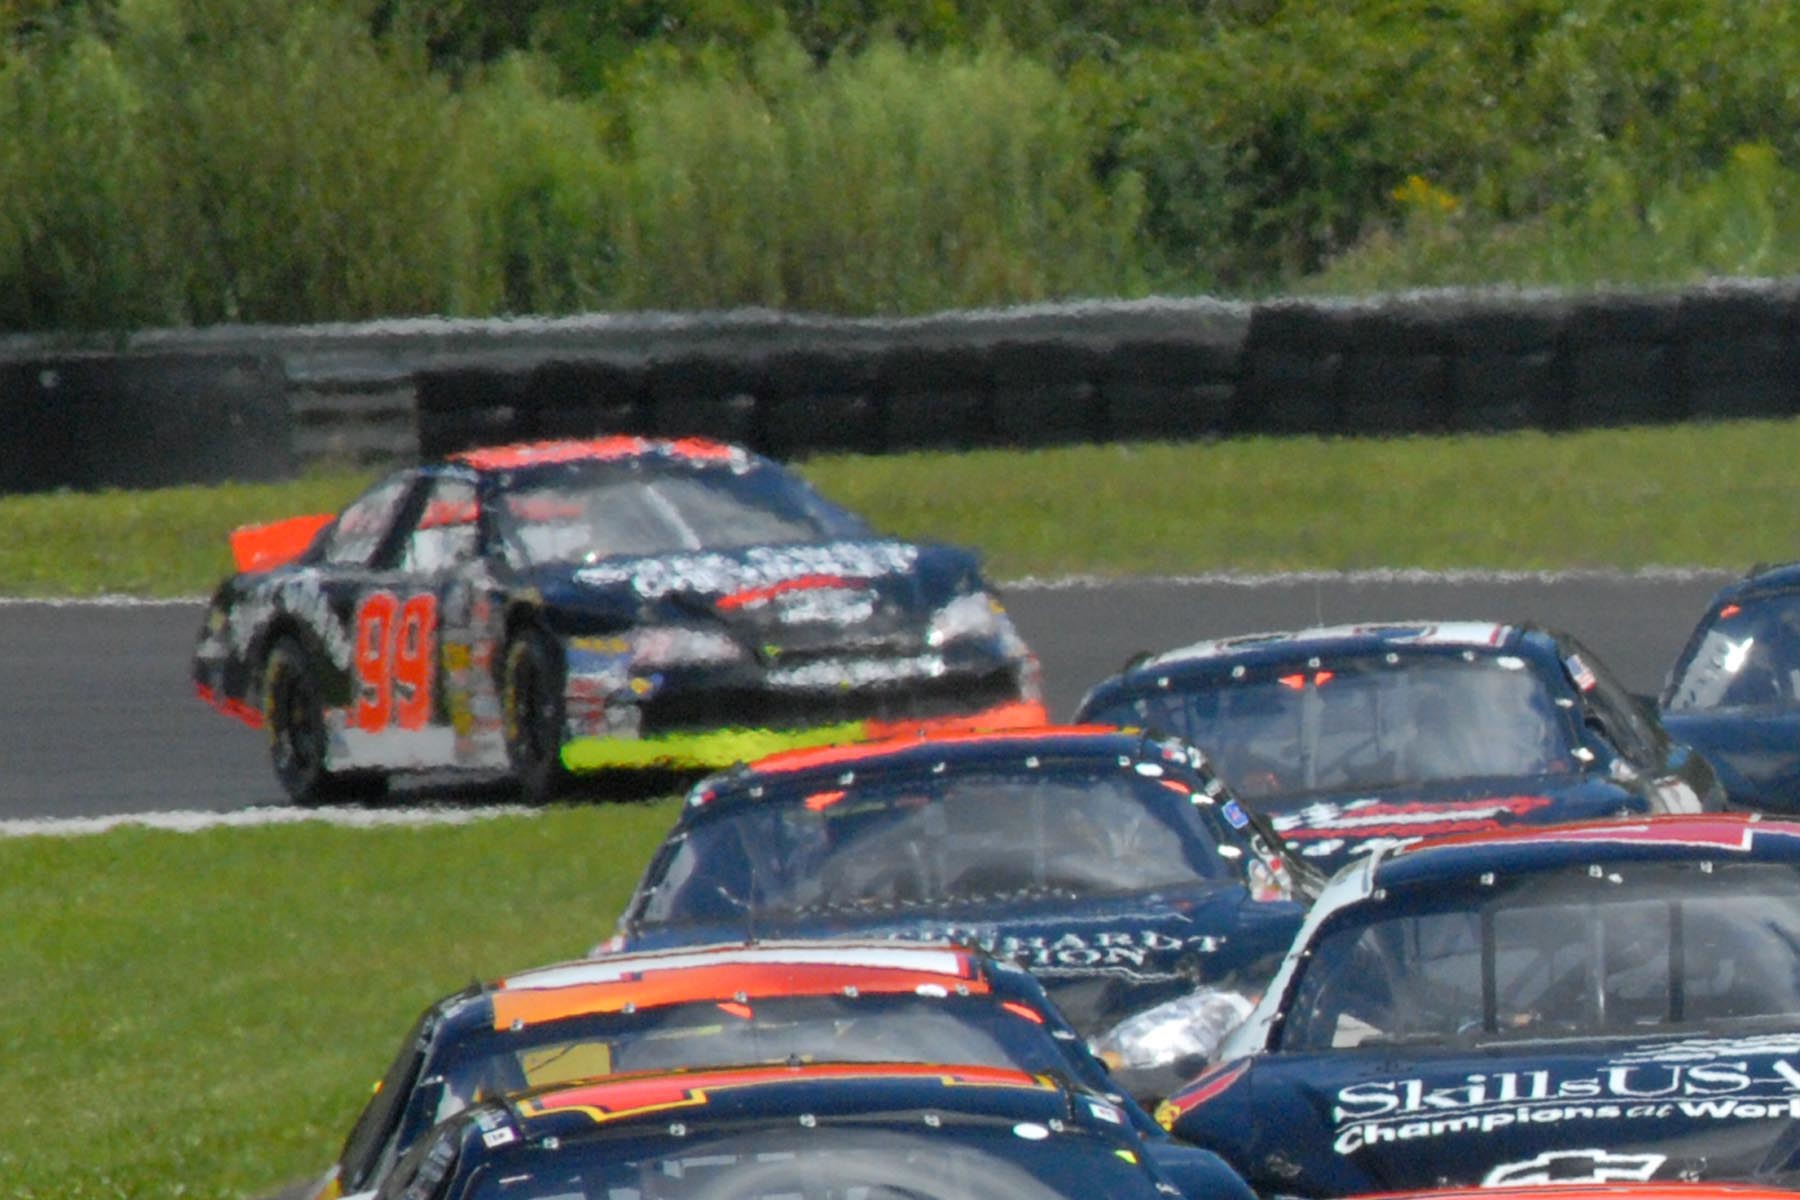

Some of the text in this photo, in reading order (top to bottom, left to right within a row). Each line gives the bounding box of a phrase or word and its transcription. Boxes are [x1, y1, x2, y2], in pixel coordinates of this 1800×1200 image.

[355, 591, 438, 735] 99
[1334, 1103, 1621, 1155] Champions
[1627, 1102, 1673, 1118] at
